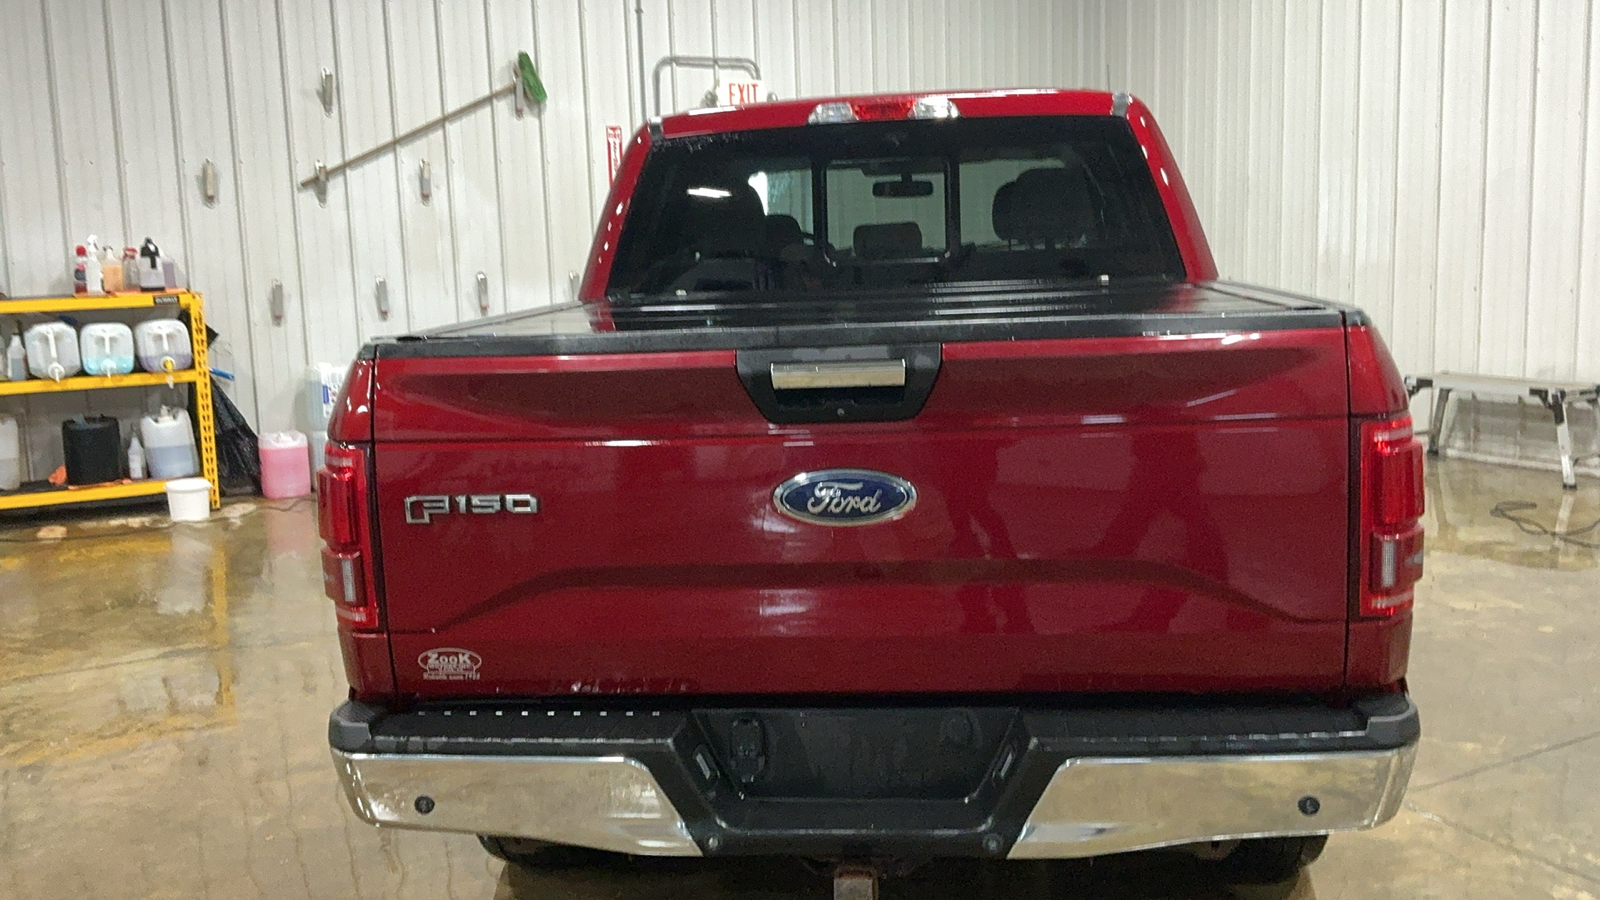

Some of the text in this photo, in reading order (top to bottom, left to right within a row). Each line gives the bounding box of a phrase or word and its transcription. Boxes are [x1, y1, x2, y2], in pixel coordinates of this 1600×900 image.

[728, 83, 759, 106] EXIT
[404, 494, 537, 524] F150
[806, 481, 883, 515] Ford
